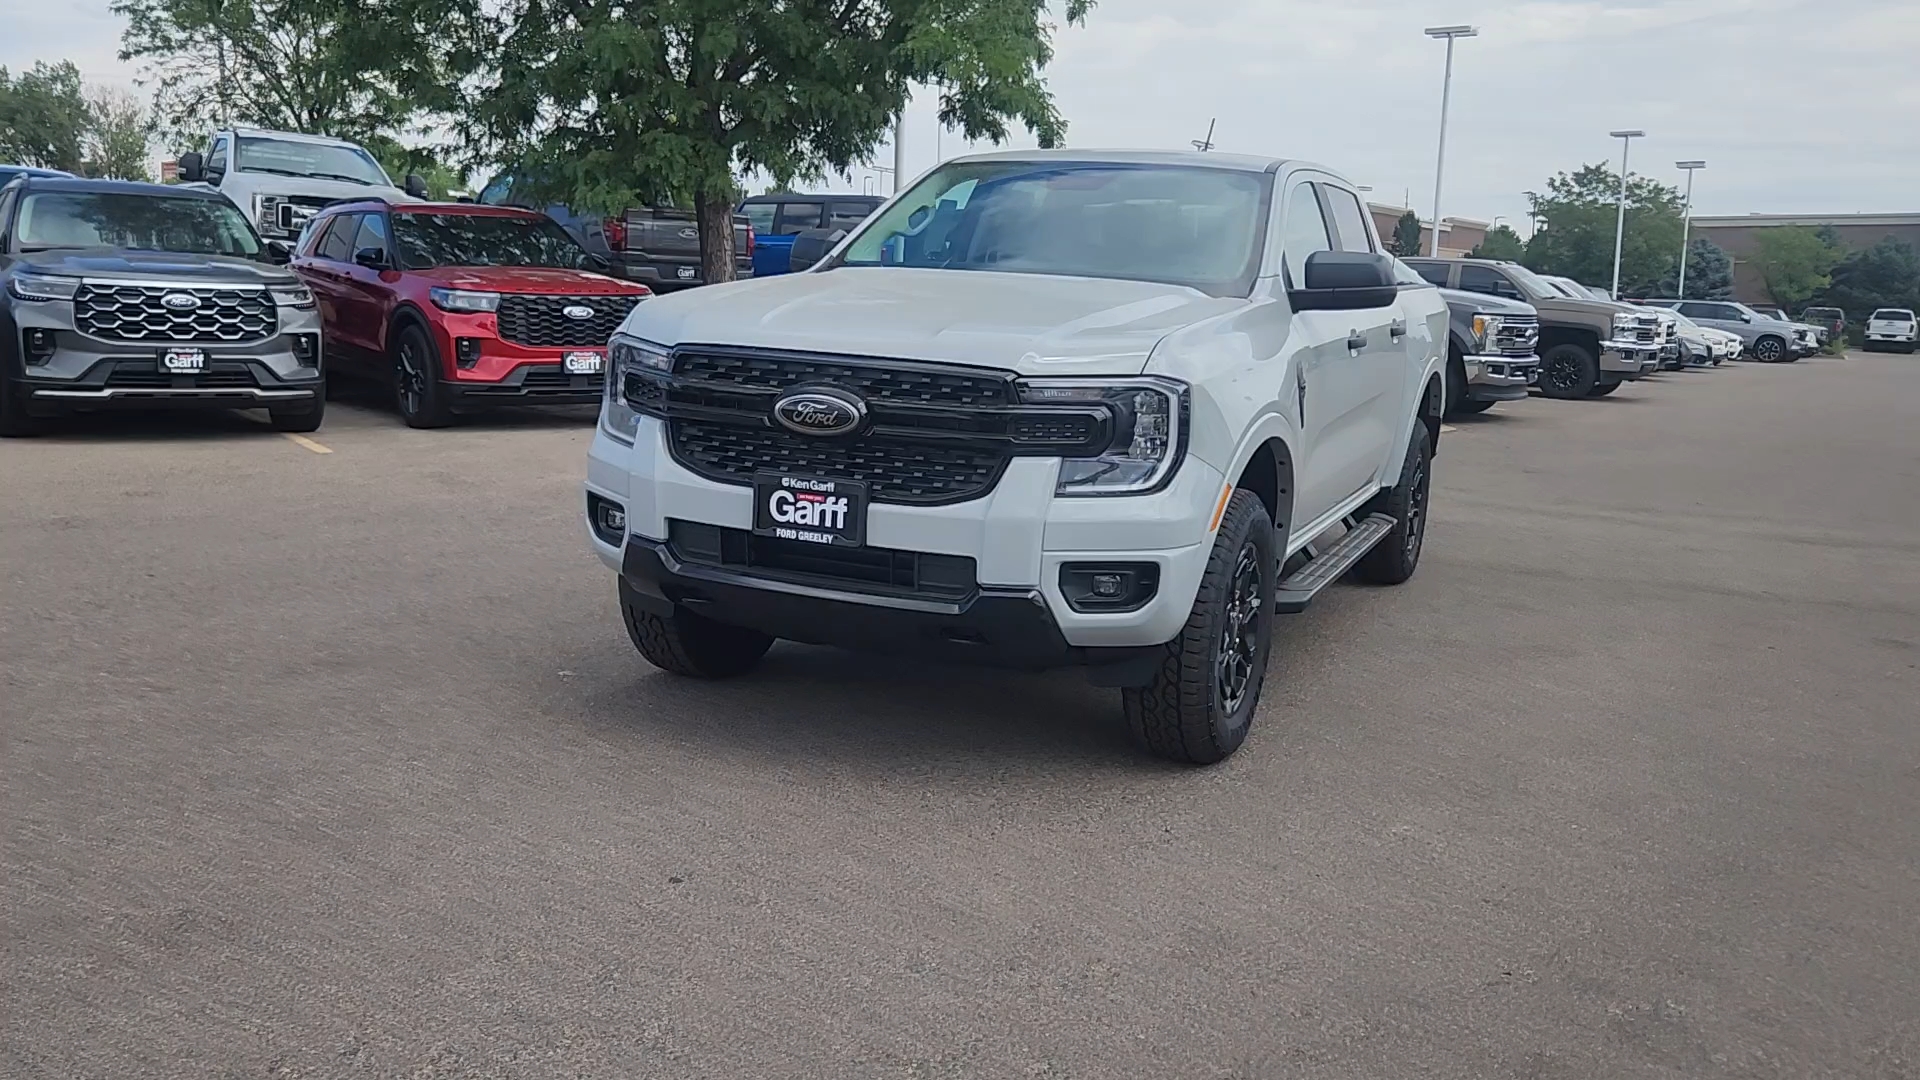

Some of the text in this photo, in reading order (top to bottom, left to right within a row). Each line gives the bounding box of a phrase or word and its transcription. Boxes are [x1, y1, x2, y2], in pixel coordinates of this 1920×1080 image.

[164, 353, 205, 368] Garff
[565, 355, 601, 370] Garff
[792, 401, 838, 426] Ford
[790, 478, 835, 492] Ken Garff
[769, 490, 848, 529] Garff
[776, 528, 833, 544] FORD GREELEY
